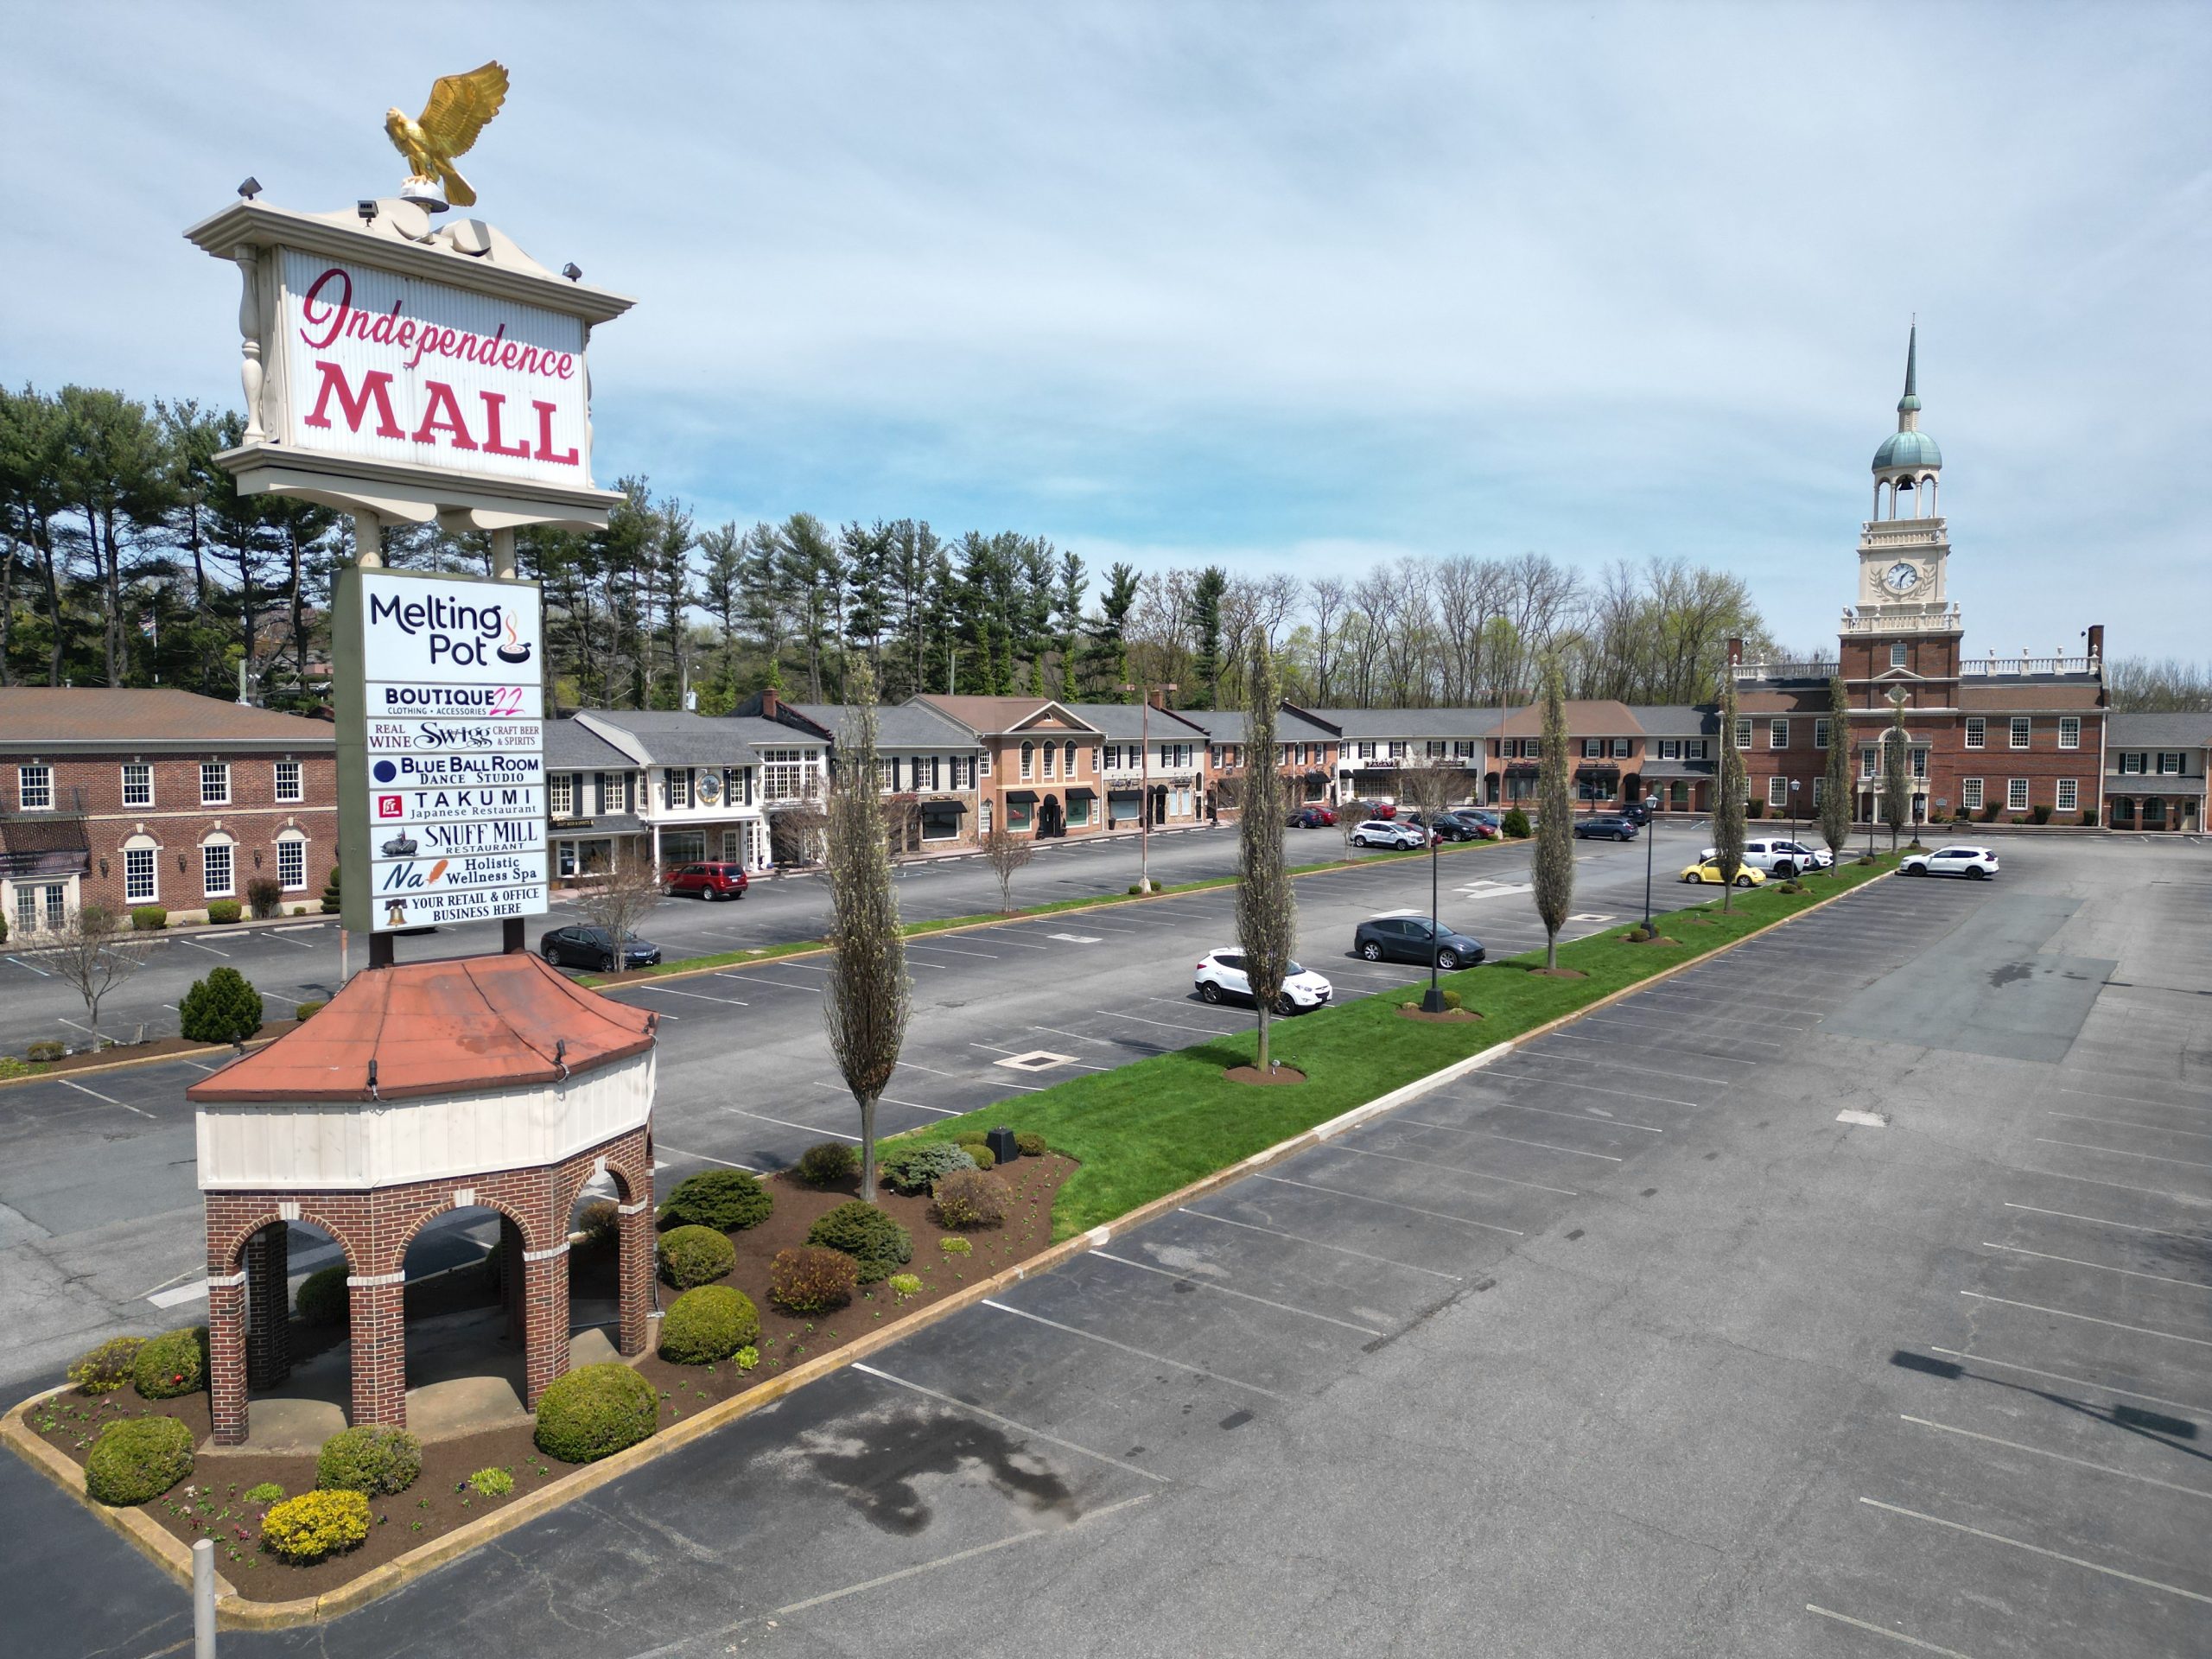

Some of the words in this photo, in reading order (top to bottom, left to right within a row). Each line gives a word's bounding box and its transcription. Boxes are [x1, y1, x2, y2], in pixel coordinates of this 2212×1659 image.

[300, 269, 575, 379] Independence
[304, 360, 579, 466] MALL
[370, 593, 501, 639] Melting
[429, 634, 487, 666] Pot
[385, 688, 495, 706] BOUTIQUE
[489, 687, 525, 715] 22
[388, 707, 427, 715] CLOTHING
[375, 724, 405, 734] REAL
[413, 721, 493, 749] Swigg
[493, 726, 518, 734] CRAFT
[519, 726, 539, 734] BEER
[369, 736, 411, 747] WINE
[504, 737, 536, 746] SPIRITS
[401, 757, 446, 774] BLUE
[420, 773, 466, 785] DANCE
[477, 772, 524, 784] STUDIO
[415, 789, 530, 808] TAKUMI
[410, 809, 467, 819] Japanese
[472, 805, 537, 816] Restaurant
[425, 823, 487, 847] SNUFF
[493, 822, 537, 842] MILL
[446, 842, 524, 854] RESTAURANT
[465, 857, 520, 870] Holistic
[447, 870, 507, 885] Wellness
[513, 868, 537, 882] Spa
[412, 896, 443, 909] YOUR
[448, 893, 486, 906] RETAIL
[491, 892, 499, 902] &
[503, 888, 539, 900] OFFICE
[433, 906, 489, 921] BUSINESS
[493, 903, 522, 915] HERE
